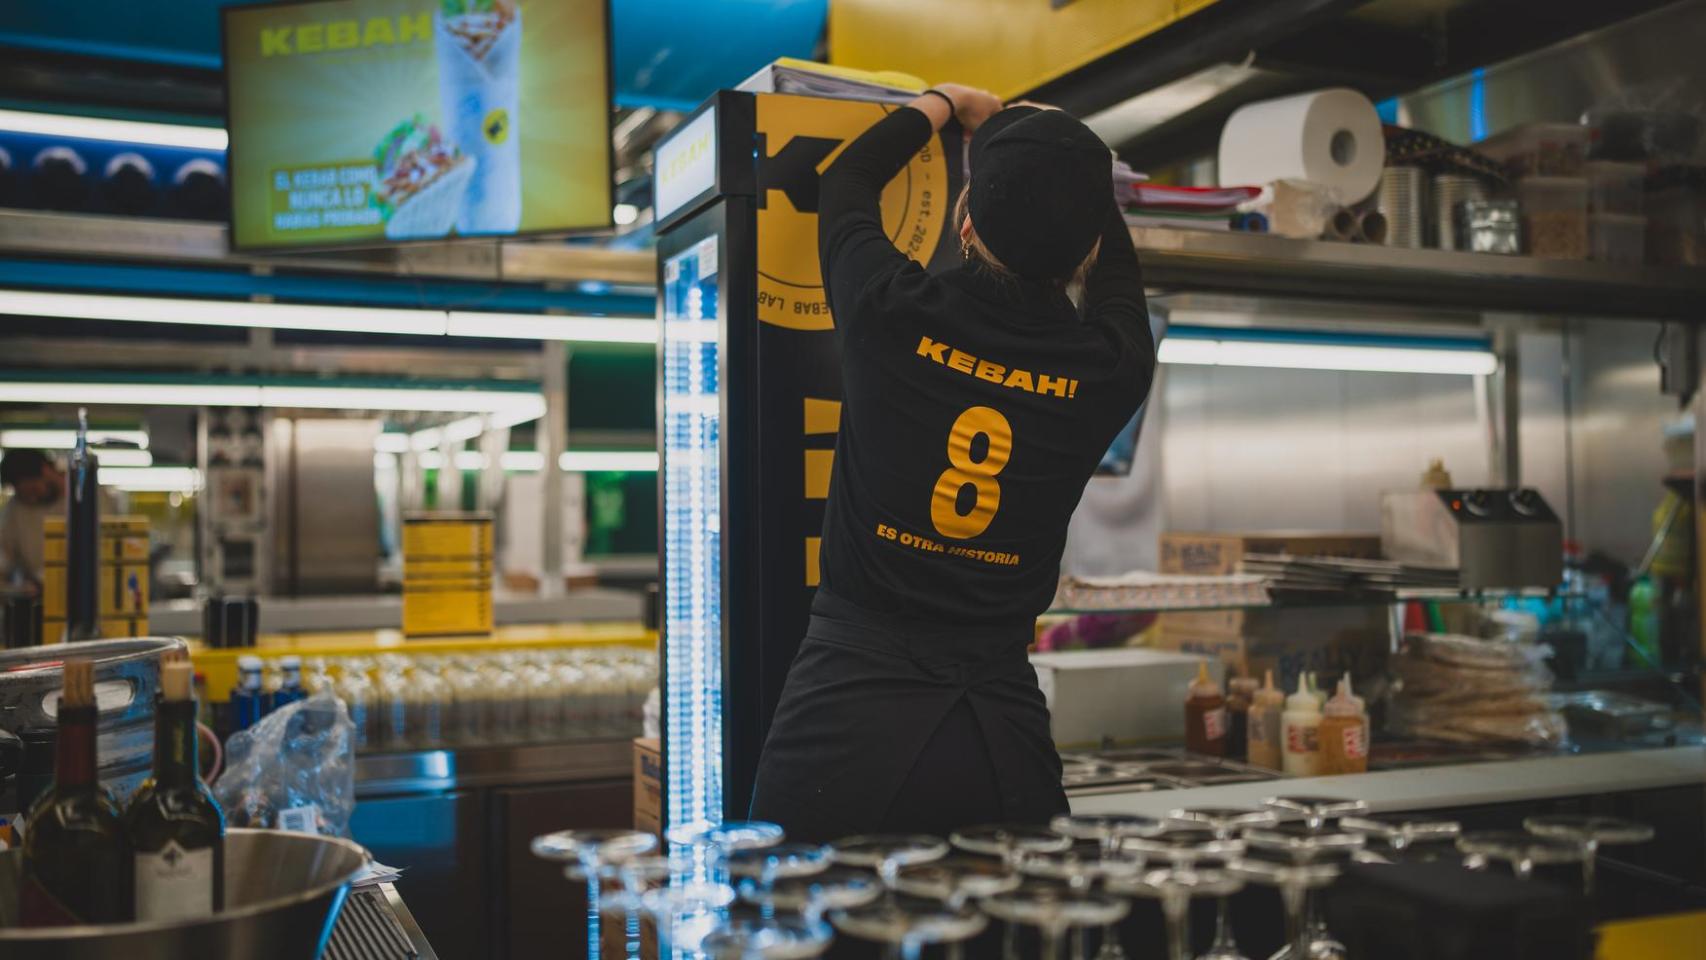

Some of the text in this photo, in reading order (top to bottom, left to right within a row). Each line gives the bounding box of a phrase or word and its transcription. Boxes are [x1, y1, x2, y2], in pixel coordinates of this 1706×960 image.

[916, 336, 1078, 399] KEBAH!
[930, 405, 1012, 540] 8
[876, 524, 1020, 565] ES OTRA HISTORIA
